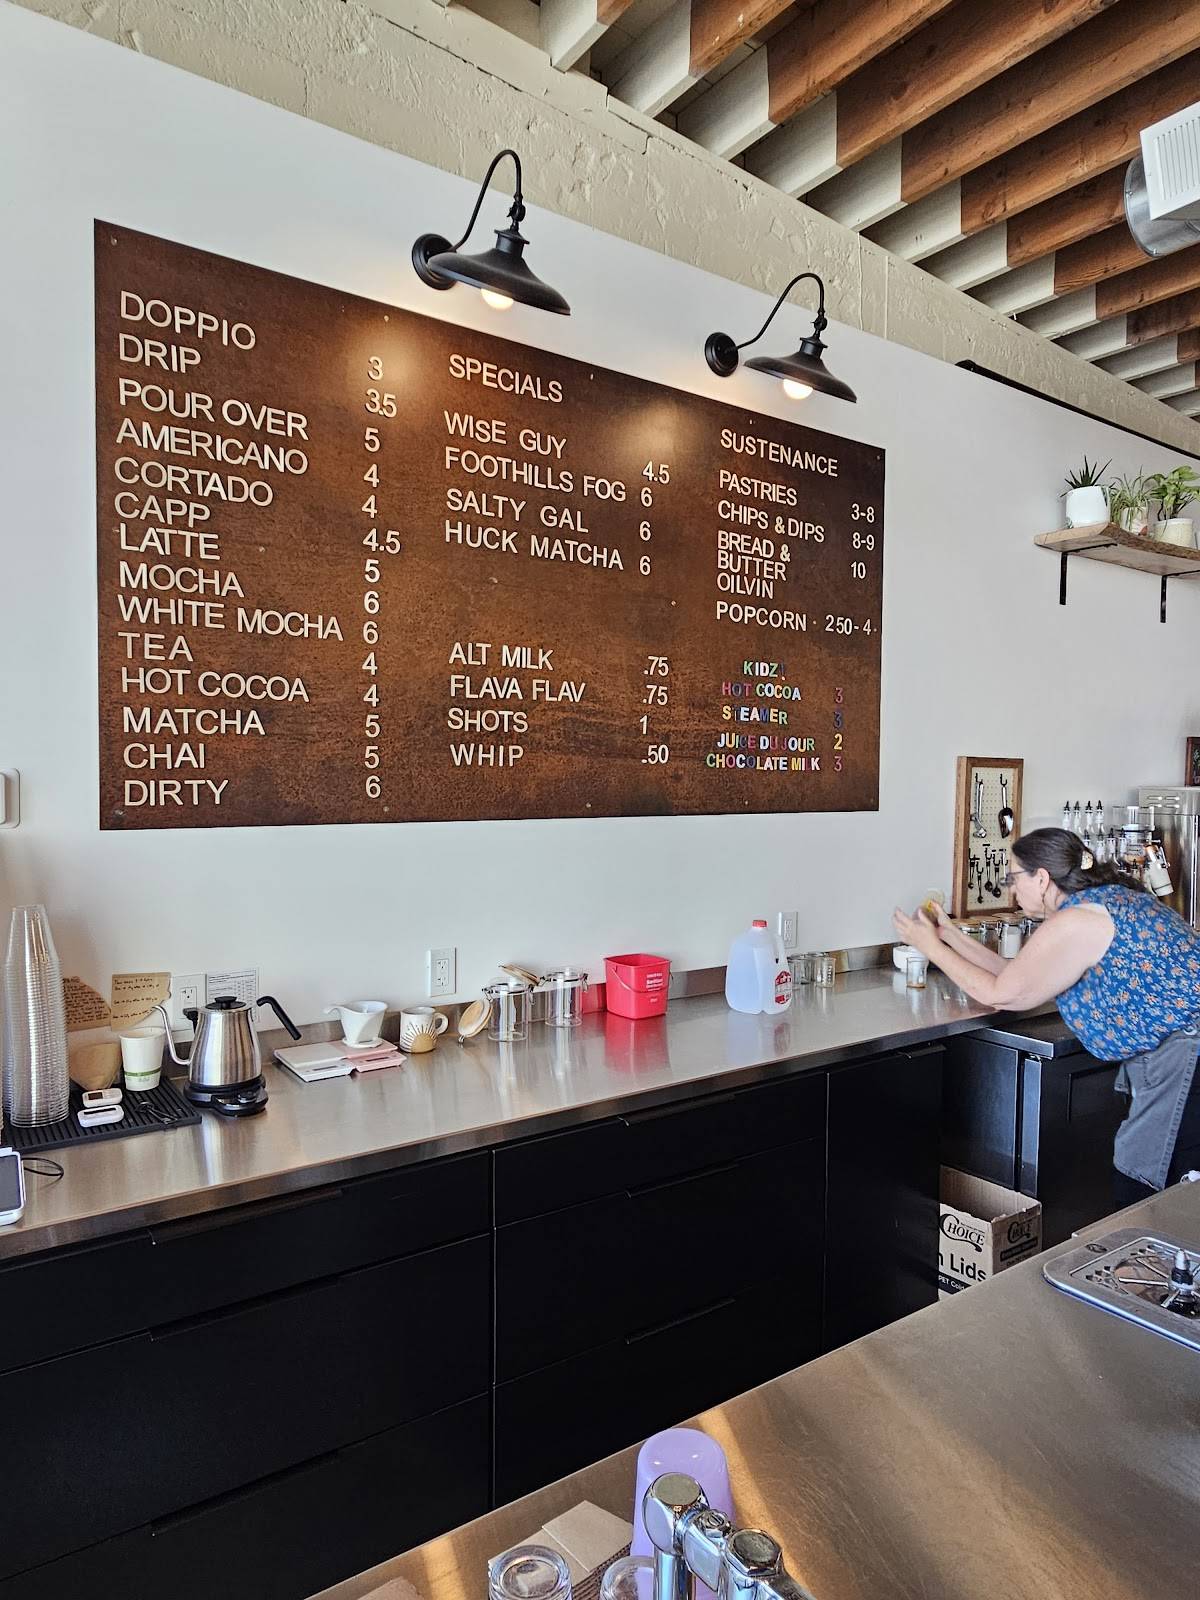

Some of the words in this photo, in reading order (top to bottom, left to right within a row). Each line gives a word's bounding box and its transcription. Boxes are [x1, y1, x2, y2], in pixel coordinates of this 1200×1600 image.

[119, 332, 201, 374] DRIP
[120, 290, 256, 350] DOPPIO
[368, 356, 384, 381] 3
[449, 353, 563, 403] SPECIALS
[119, 377, 215, 422] POUR
[222, 399, 309, 441] OVER
[364, 427, 381, 452] 5
[115, 417, 309, 475] AMERICANO
[363, 463, 380, 488] 4
[444, 410, 507, 445] WISE
[518, 428, 567, 459] GUY
[642, 461, 670, 484] 4.5
[720, 429, 838, 477] SUSTENANCE
[114, 456, 274, 507] CORTADO
[361, 494, 378, 518] 4
[445, 446, 574, 493] FOOTHILLS
[583, 475, 627, 502] FOG
[640, 487, 653, 507] 6
[719, 469, 798, 506] PASTRIES
[851, 503, 875, 523] 3-8
[114, 491, 211, 528] CAPP
[362, 528, 401, 554] 4.5
[446, 488, 527, 522] SALTY
[539, 505, 589, 533] GAL
[639, 521, 651, 541] 6
[717, 500, 769, 530] CHIPS
[852, 532, 875, 551] 8-9
[119, 522, 221, 560] LATTE
[364, 559, 380, 583] 5
[445, 519, 518, 554] HUCK
[530, 535, 624, 571] MATCHA
[639, 556, 651, 575] 6
[717, 530, 774, 558] BREAD
[780, 544, 791, 562] &
[850, 561, 866, 579] 10
[717, 550, 787, 581] BUTTER
[119, 560, 245, 598] MOCHA
[363, 591, 380, 614] 6
[717, 572, 774, 599] OILVIN
[117, 594, 225, 629] WHITE
[237, 607, 344, 642] MOCHA
[362, 621, 379, 645] 6
[716, 600, 807, 632] POPCORN
[118, 632, 194, 662] TEA
[361, 652, 378, 675] 4
[448, 641, 492, 666] ALT
[501, 645, 554, 671] MILK
[643, 655, 669, 676] .75
[121, 667, 191, 695] HOT
[197, 671, 310, 703] COCOA
[363, 684, 380, 708] 4
[450, 674, 523, 700] FLAVA
[532, 679, 586, 703] FLAV
[642, 684, 669, 706] .75
[722, 682, 751, 697] HOT
[756, 683, 802, 700] COCOA
[835, 688, 843, 703] 3
[122, 706, 266, 736] MATCHA
[365, 714, 381, 738] 5
[448, 707, 529, 733] SHOTS
[639, 715, 648, 735] 1
[722, 705, 788, 725] STEAMER
[834, 711, 843, 728] 3
[123, 743, 205, 770] CHAI
[364, 745, 380, 769] 5
[449, 743, 524, 767] WHIP
[641, 744, 669, 765] .50
[706, 753, 788, 771] CHOCOLATE
[791, 757, 821, 771] MILK
[834, 756, 842, 772] 3
[717, 732, 756, 749] JUICE
[759, 736, 778, 750] DU
[781, 736, 815, 752] JOUR
[833, 733, 843, 750] 2
[124, 779, 229, 806] DIRTY
[364, 776, 381, 798] 6
[940, 1214, 985, 1252] CHOICE
[950, 1253, 986, 1282] Lids
